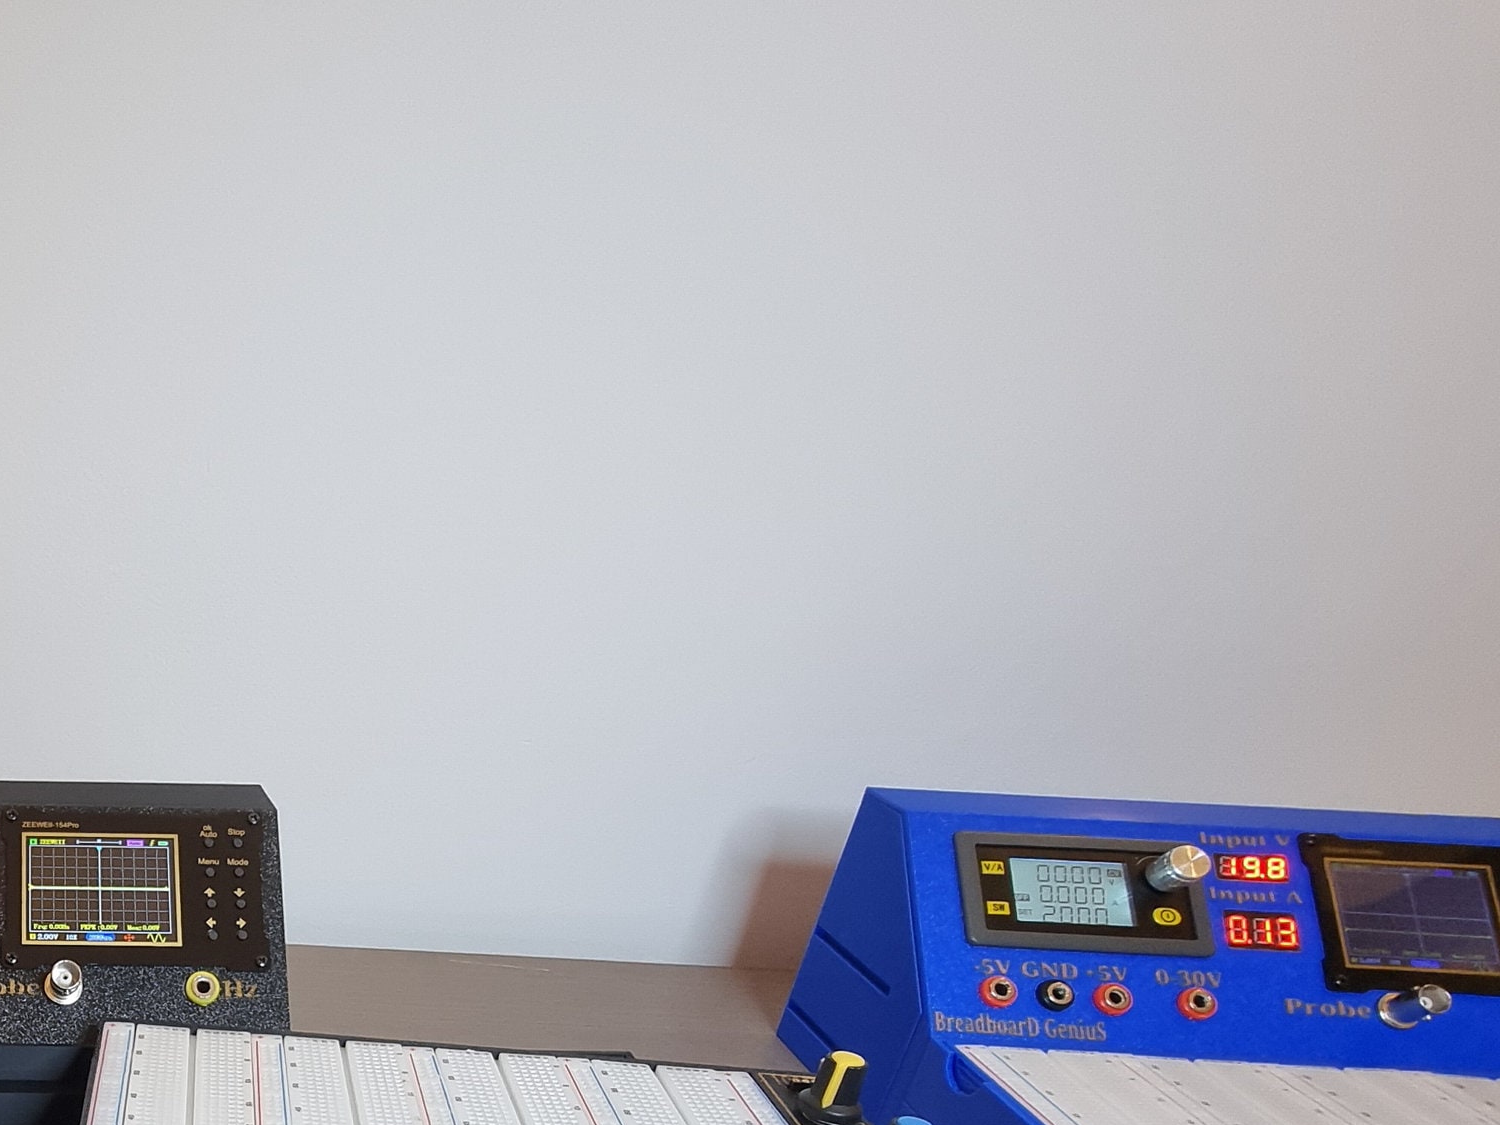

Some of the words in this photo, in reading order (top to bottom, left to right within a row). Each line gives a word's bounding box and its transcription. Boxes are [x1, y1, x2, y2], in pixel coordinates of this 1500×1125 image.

[199, 830, 218, 838] Auto
[1199, 831, 1266, 849] Input
[197, 857, 220, 866] Menu
[227, 857, 249, 866] Mode
[983, 863, 1004, 872] V/A
[992, 903, 1006, 912] SW
[1021, 961, 1079, 979] GND
[1284, 997, 1372, 1020] Probe
